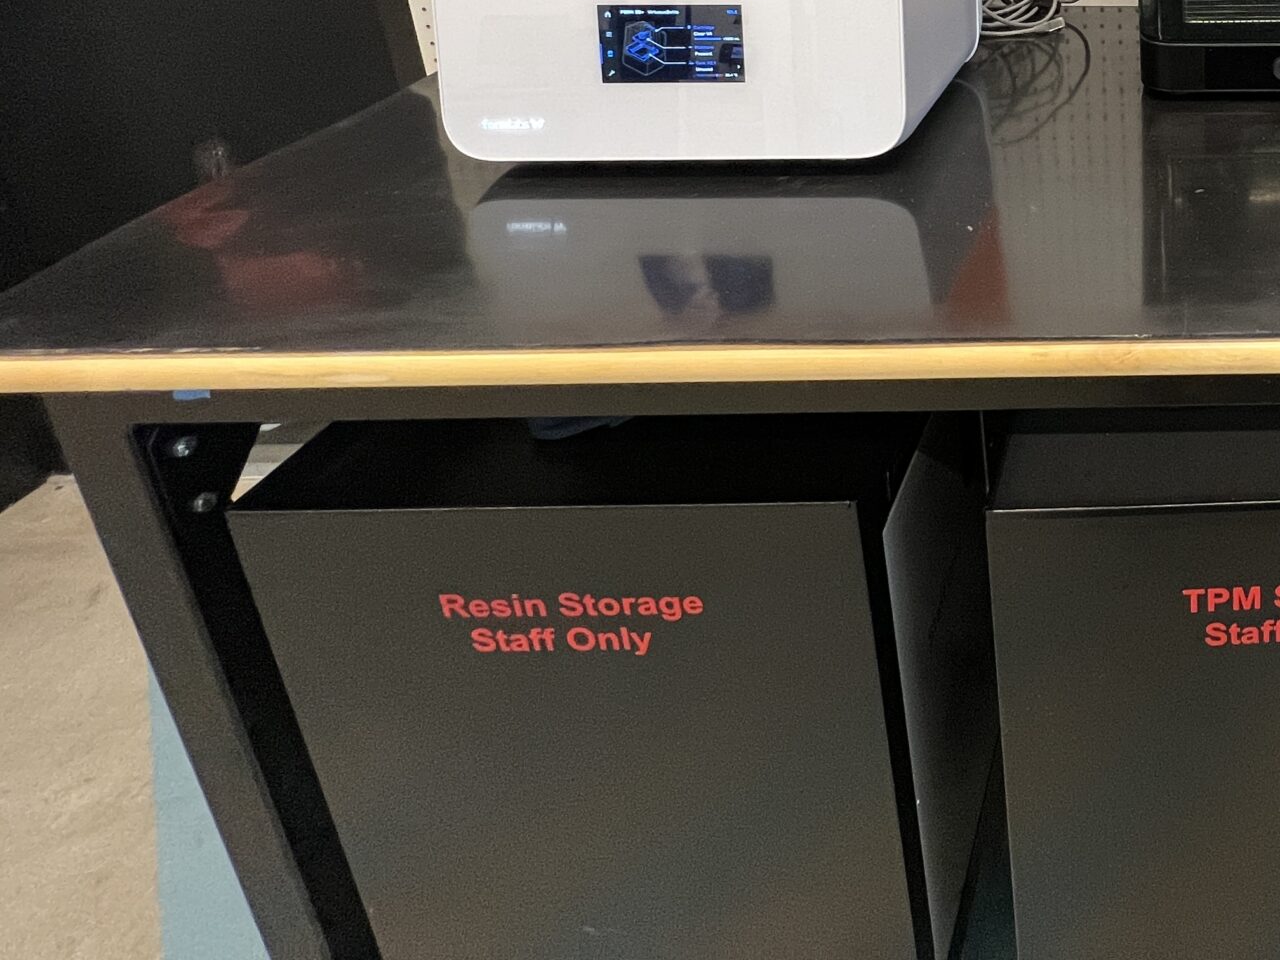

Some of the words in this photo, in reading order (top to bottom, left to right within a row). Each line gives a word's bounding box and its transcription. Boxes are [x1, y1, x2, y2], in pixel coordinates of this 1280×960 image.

[438, 593, 548, 619] Resin
[558, 592, 704, 622] Storage
[1182, 586, 1262, 613] TPM
[470, 627, 555, 653] Staff
[566, 626, 652, 656] Only
